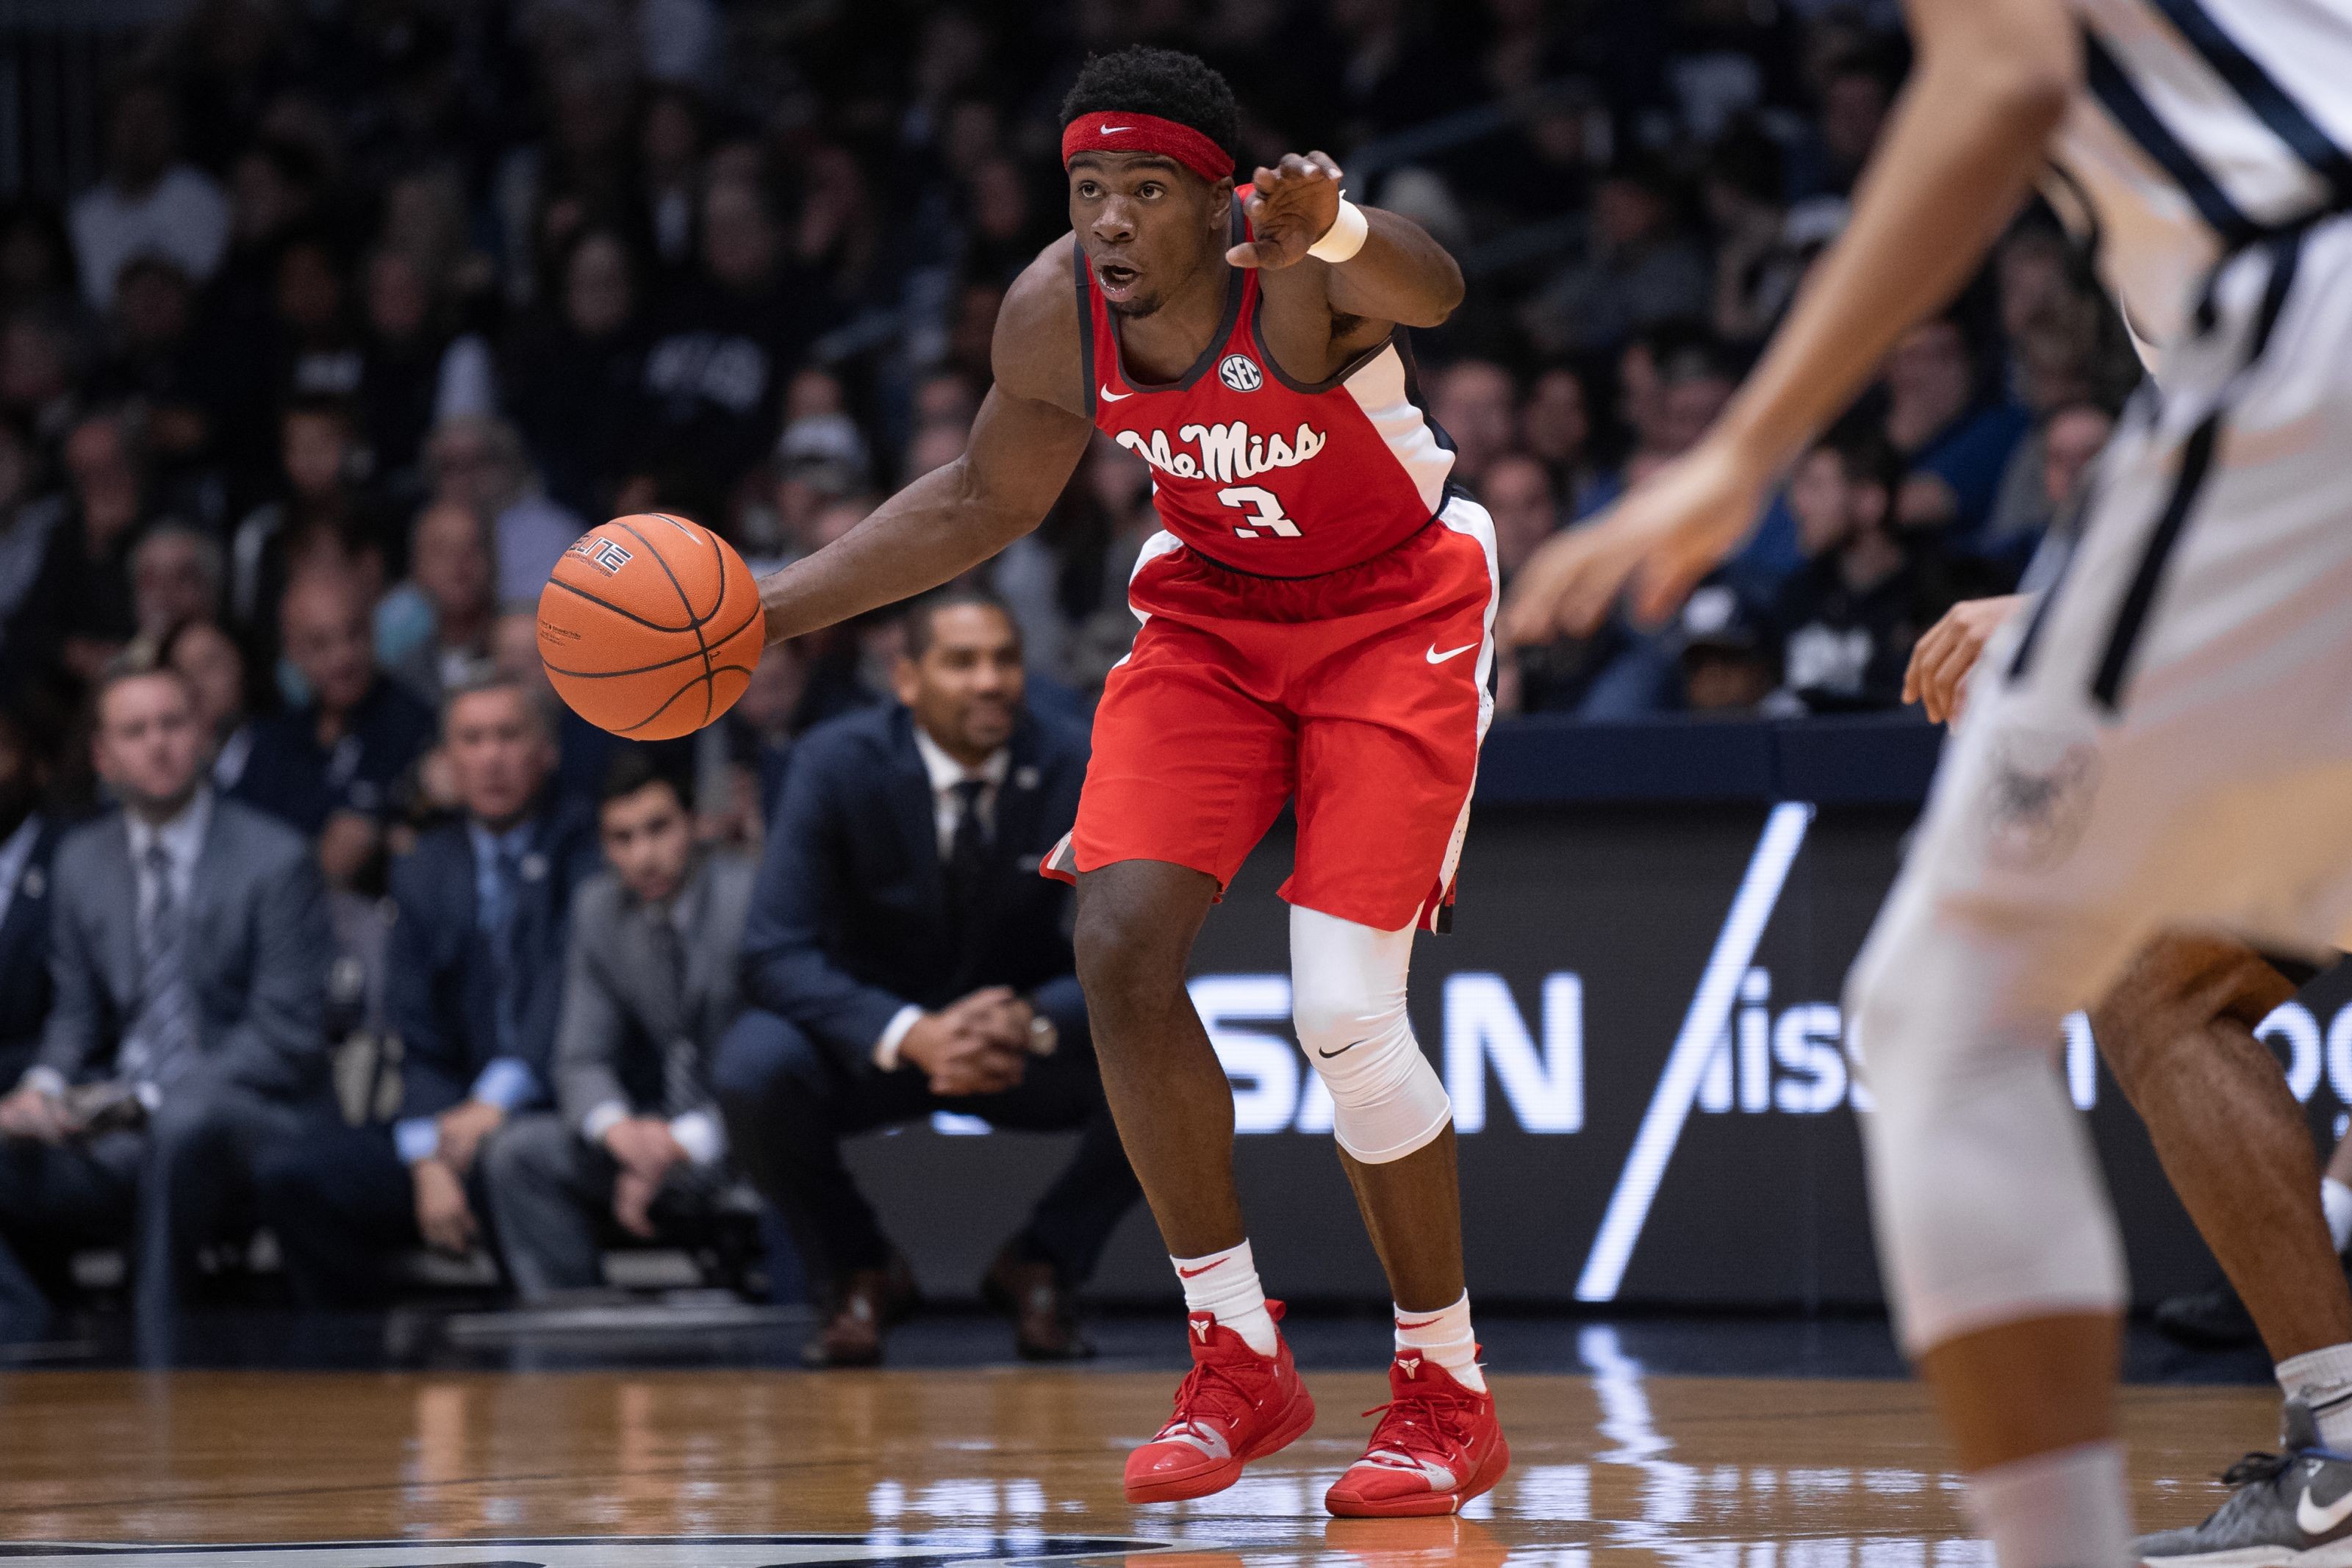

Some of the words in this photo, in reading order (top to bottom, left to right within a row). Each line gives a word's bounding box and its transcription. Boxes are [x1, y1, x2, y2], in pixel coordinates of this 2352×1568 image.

[1221, 356, 1261, 391] SEC
[1179, 420, 1327, 484] Miss
[1216, 485, 1303, 539] 3
